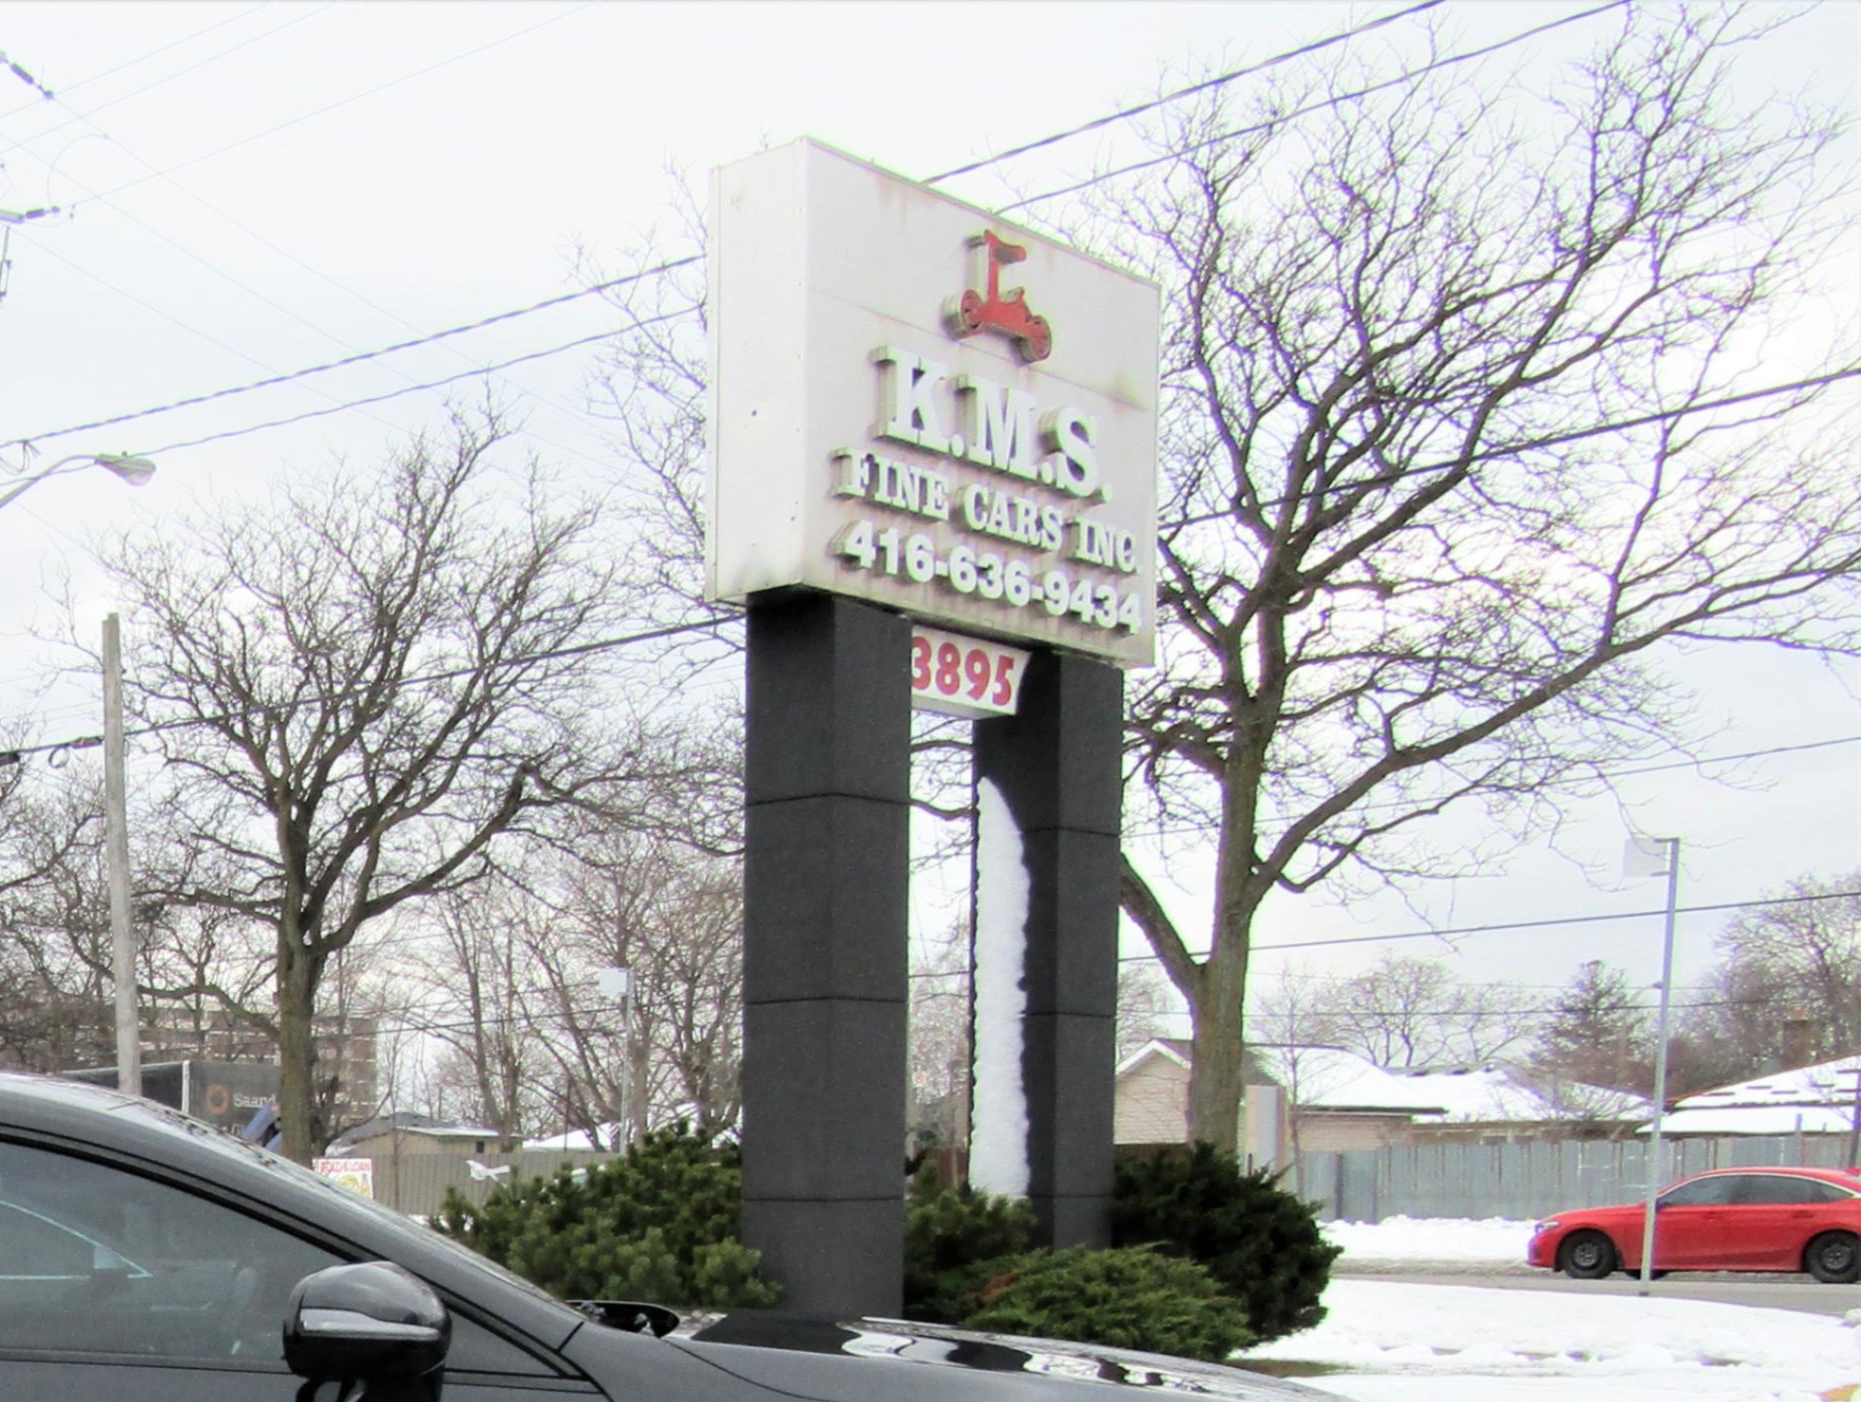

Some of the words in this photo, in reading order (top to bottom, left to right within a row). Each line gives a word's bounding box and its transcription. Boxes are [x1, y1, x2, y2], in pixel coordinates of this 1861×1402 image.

[872, 348, 1113, 503] K.M.S.
[832, 448, 950, 521] FINE
[960, 483, 1063, 550] CARS
[834, 519, 1140, 635] 416-636-9434
[910, 635, 1015, 706] 3895
